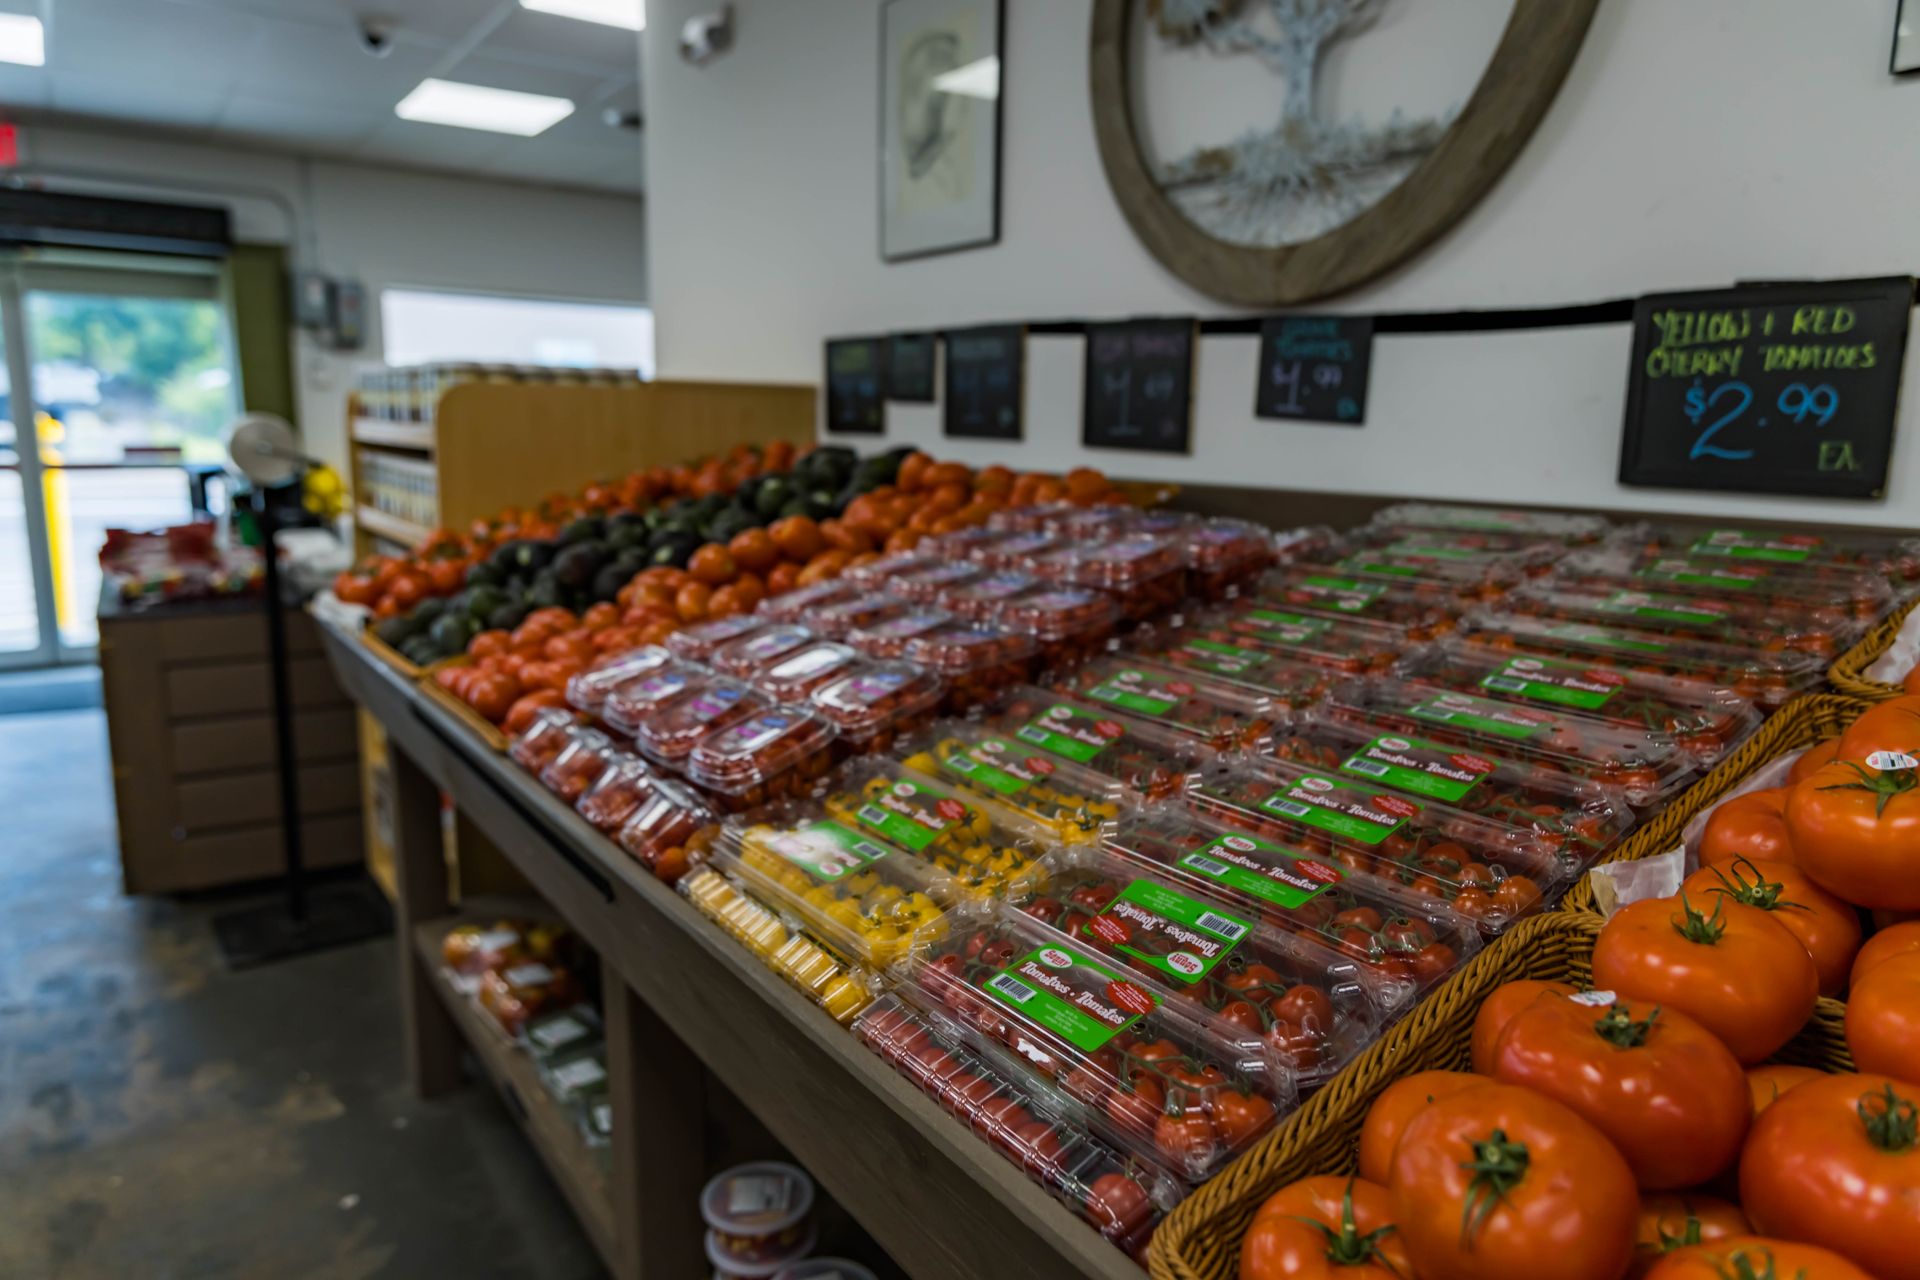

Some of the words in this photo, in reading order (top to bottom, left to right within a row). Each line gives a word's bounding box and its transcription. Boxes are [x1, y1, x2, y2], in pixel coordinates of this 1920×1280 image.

[1653, 309, 1751, 346] YELLOW
[1791, 306, 1855, 335] RED
[1646, 345, 1744, 377] CHERRY
[1758, 342, 1876, 371] TOMATOES
[1683, 379, 1839, 460] $2.99
[1287, 787, 1339, 809] Tomatoes
[1347, 803, 1398, 826] Tomates
[1208, 845, 1261, 871] Tomatoes
[1268, 865, 1319, 892] Tomates
[1112, 902, 1160, 931] Tomates
[1164, 925, 1222, 958] Tomatoes
[1019, 961, 1071, 994] Tomatoes
[1076, 991, 1126, 1025] Tomates
